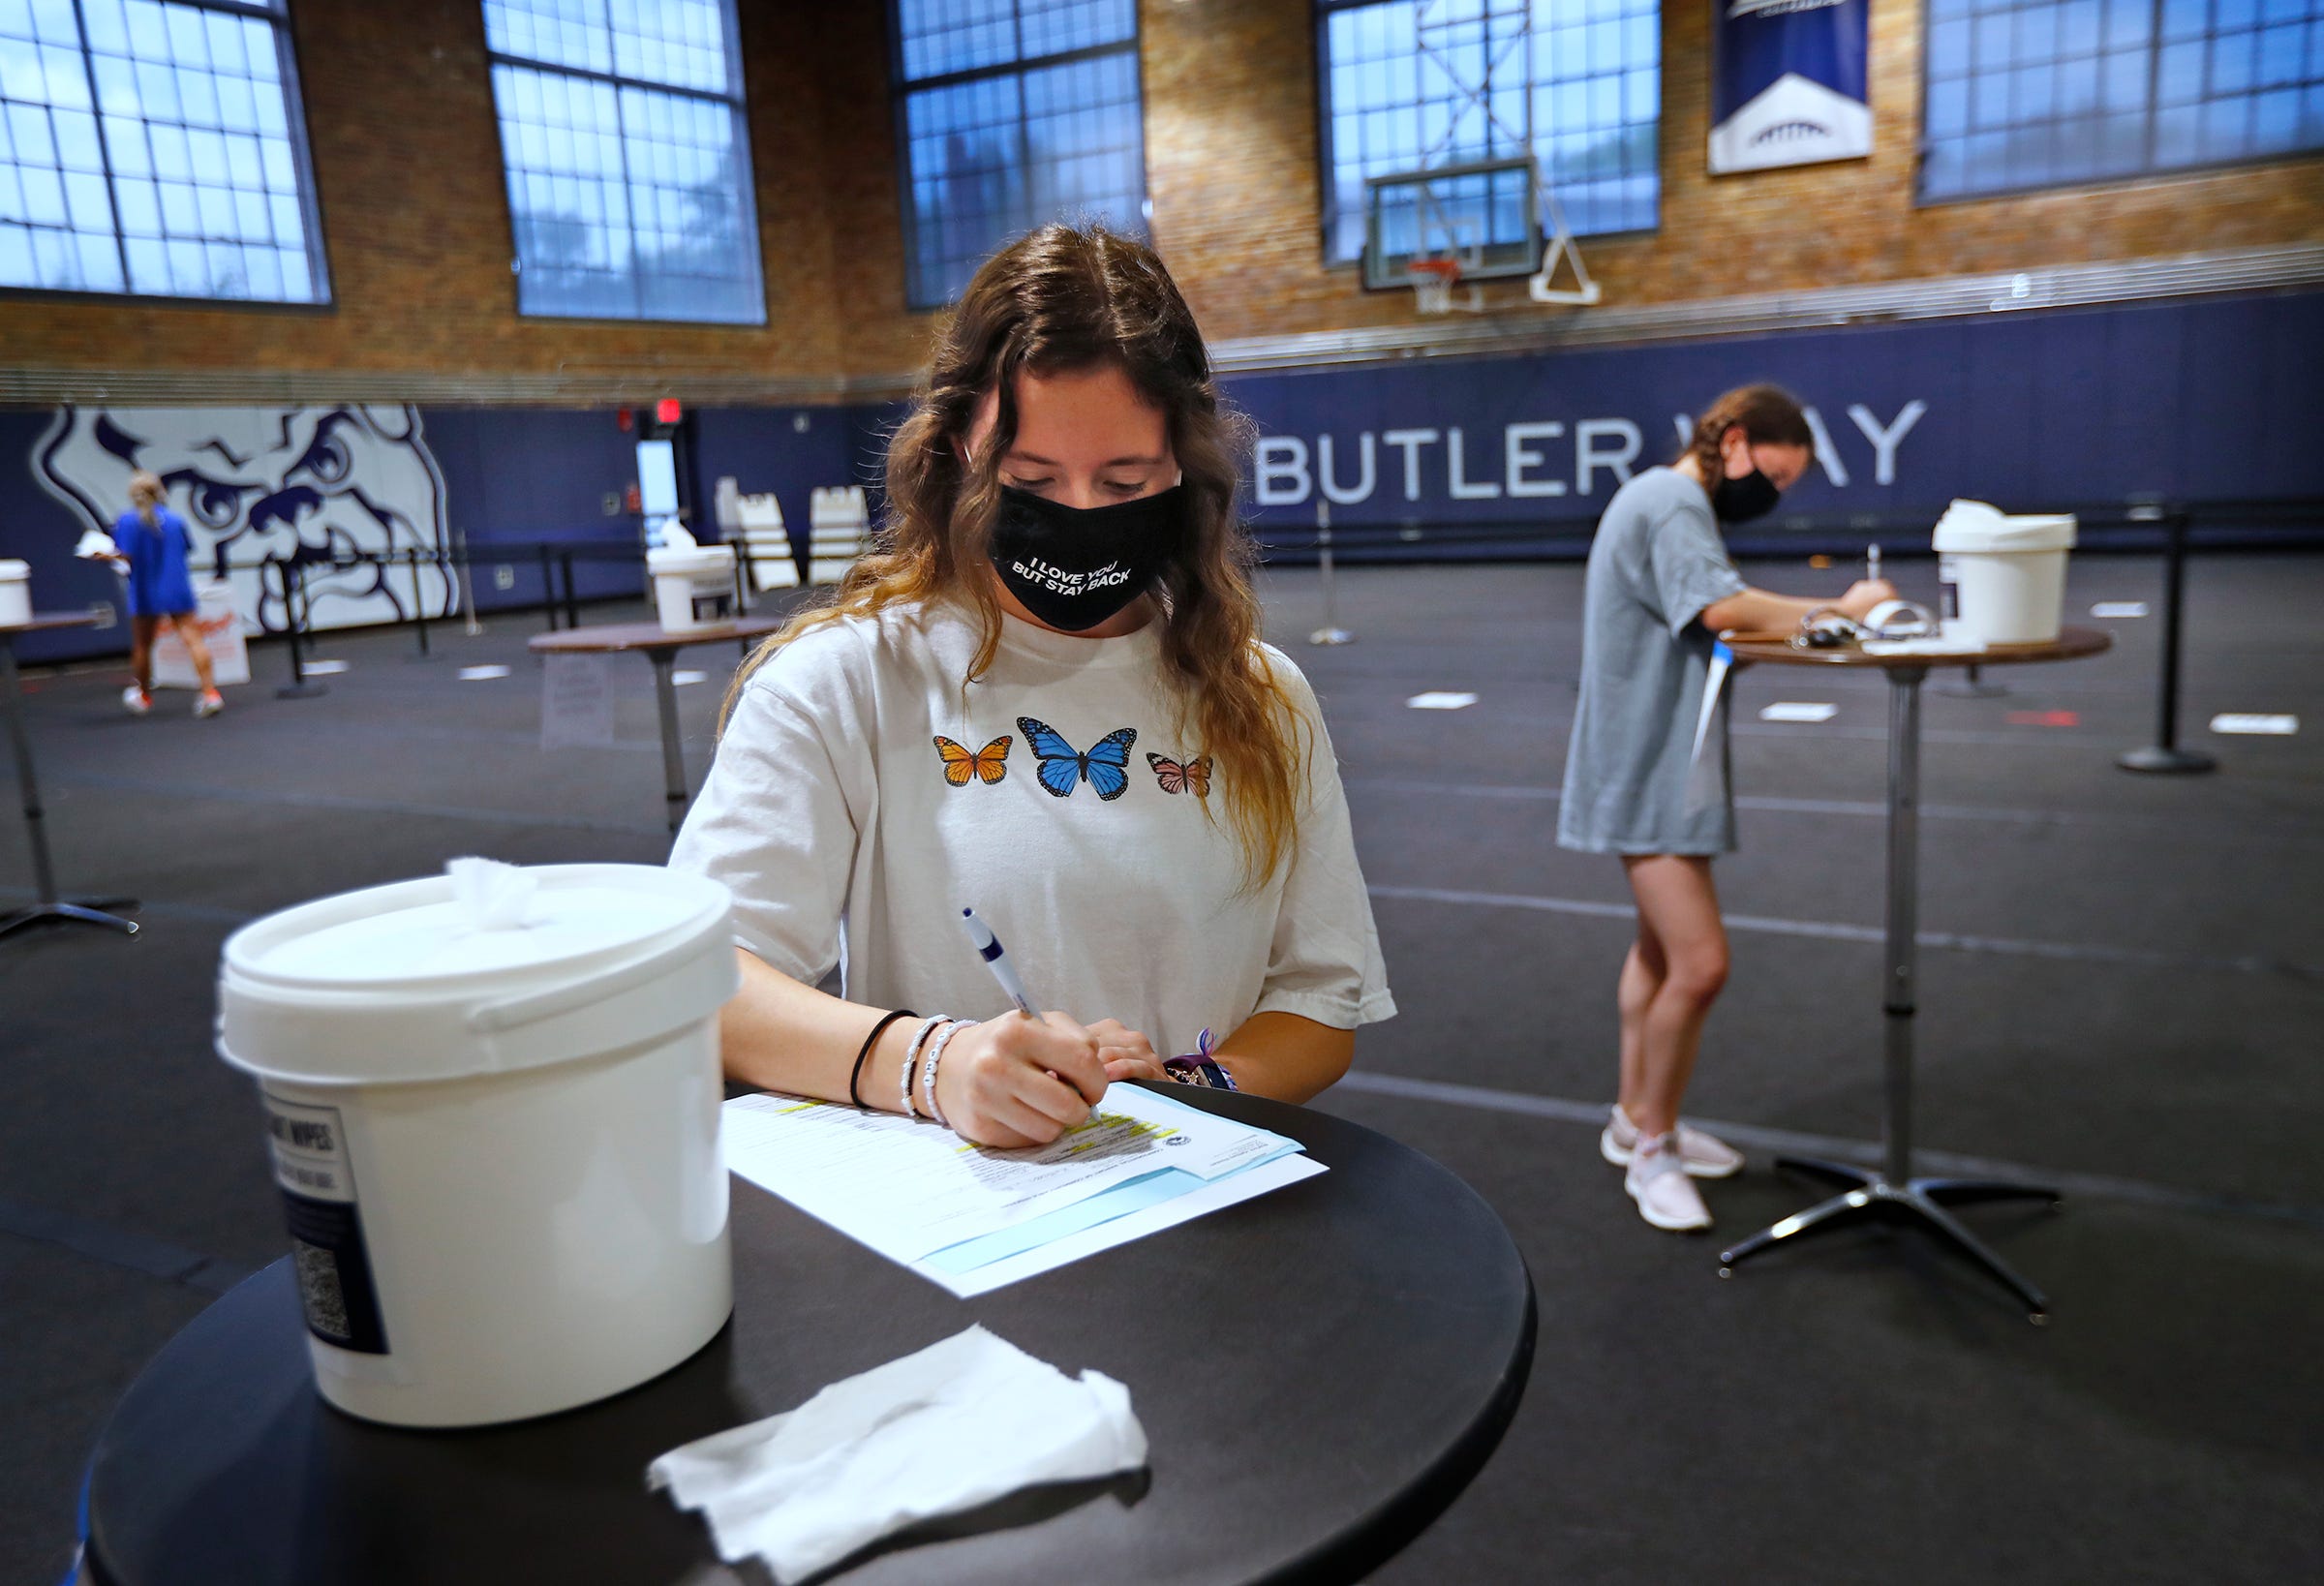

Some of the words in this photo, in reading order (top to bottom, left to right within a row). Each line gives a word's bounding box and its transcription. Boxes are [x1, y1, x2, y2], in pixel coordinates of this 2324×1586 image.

[1255, 417, 1643, 505] BUTLER
[1012, 561, 1046, 584] BUT
[1045, 579, 1088, 595] STAY
[1086, 568, 1131, 591] BACK
[1029, 557, 1038, 568] I
[1039, 560, 1085, 584] LOVE
[1087, 560, 1118, 581] YOU
